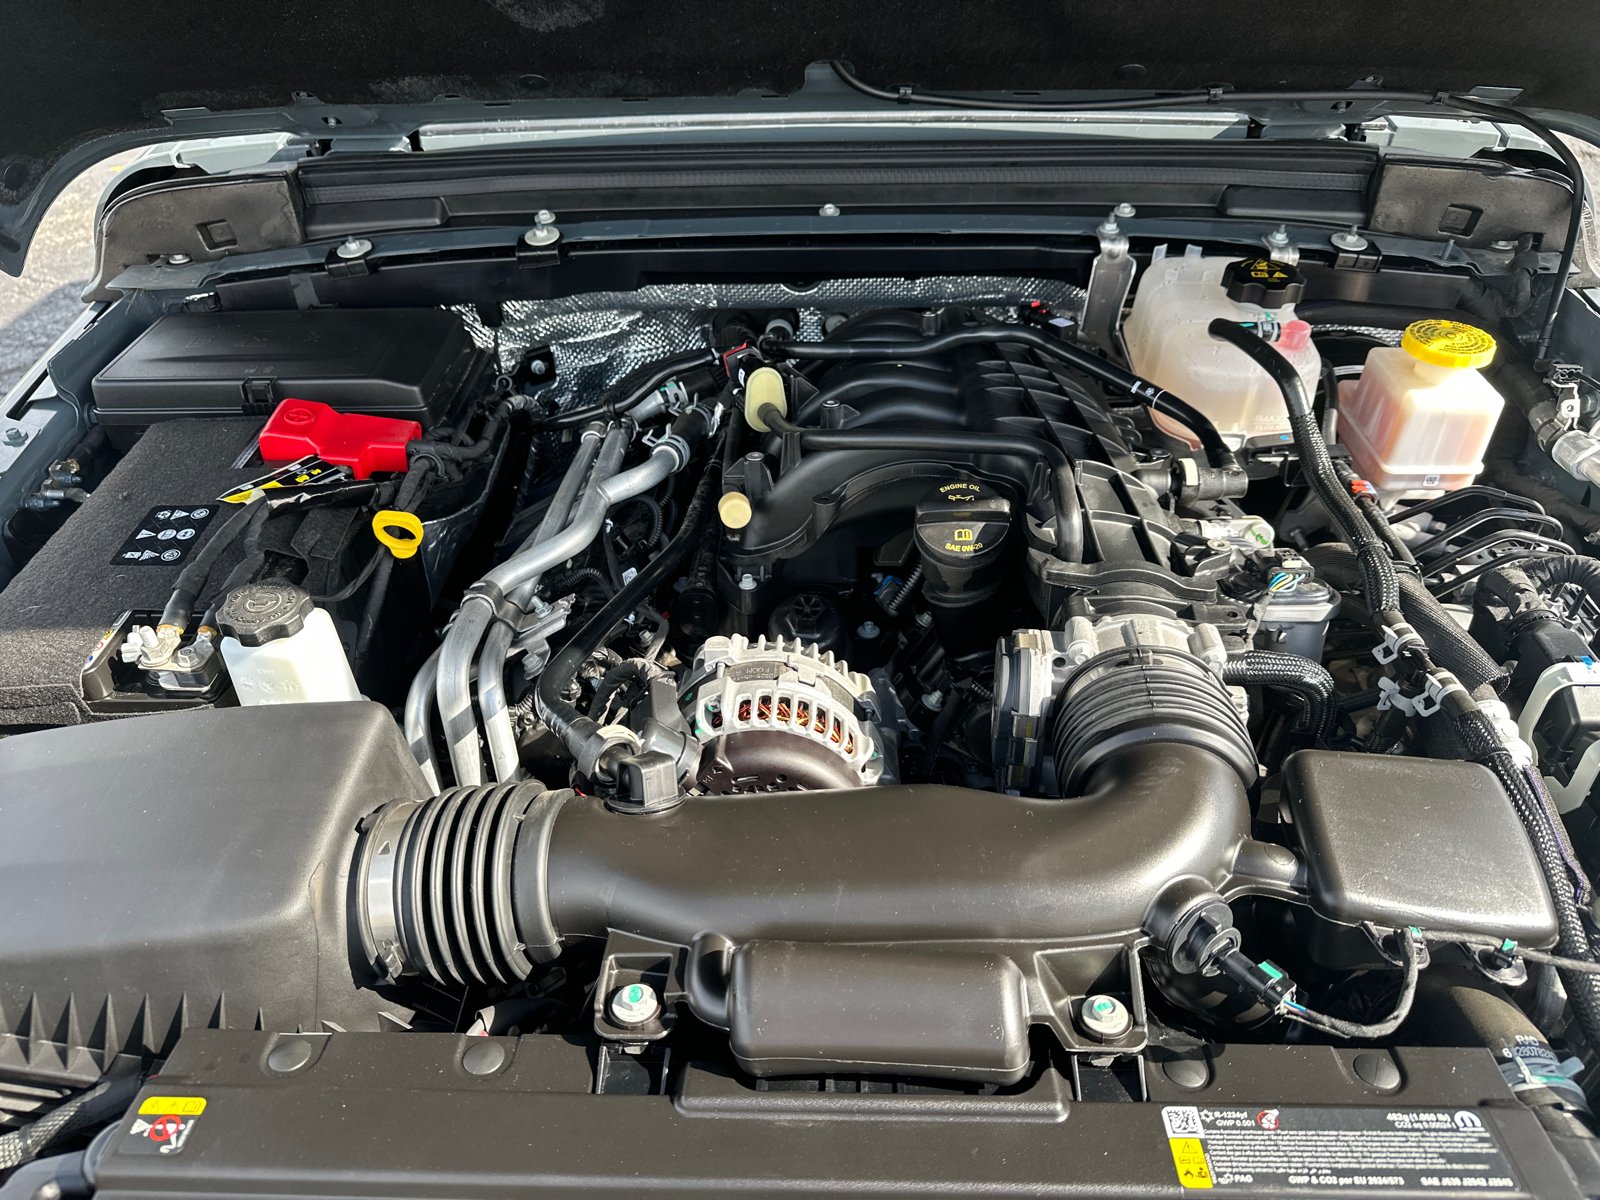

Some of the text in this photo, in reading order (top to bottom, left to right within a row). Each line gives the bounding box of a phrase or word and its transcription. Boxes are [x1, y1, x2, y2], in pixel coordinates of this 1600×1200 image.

[939, 483, 981, 493] ENGINE OIL
[944, 542, 983, 552] SAE 0W-20
[1514, 1034, 1539, 1046] RAD
[1233, 1174, 1254, 1184] PAG
[1288, 1175, 1310, 1184] GWP
[1319, 1175, 1338, 1185] CO2
[1353, 1176, 1367, 1185] EU
